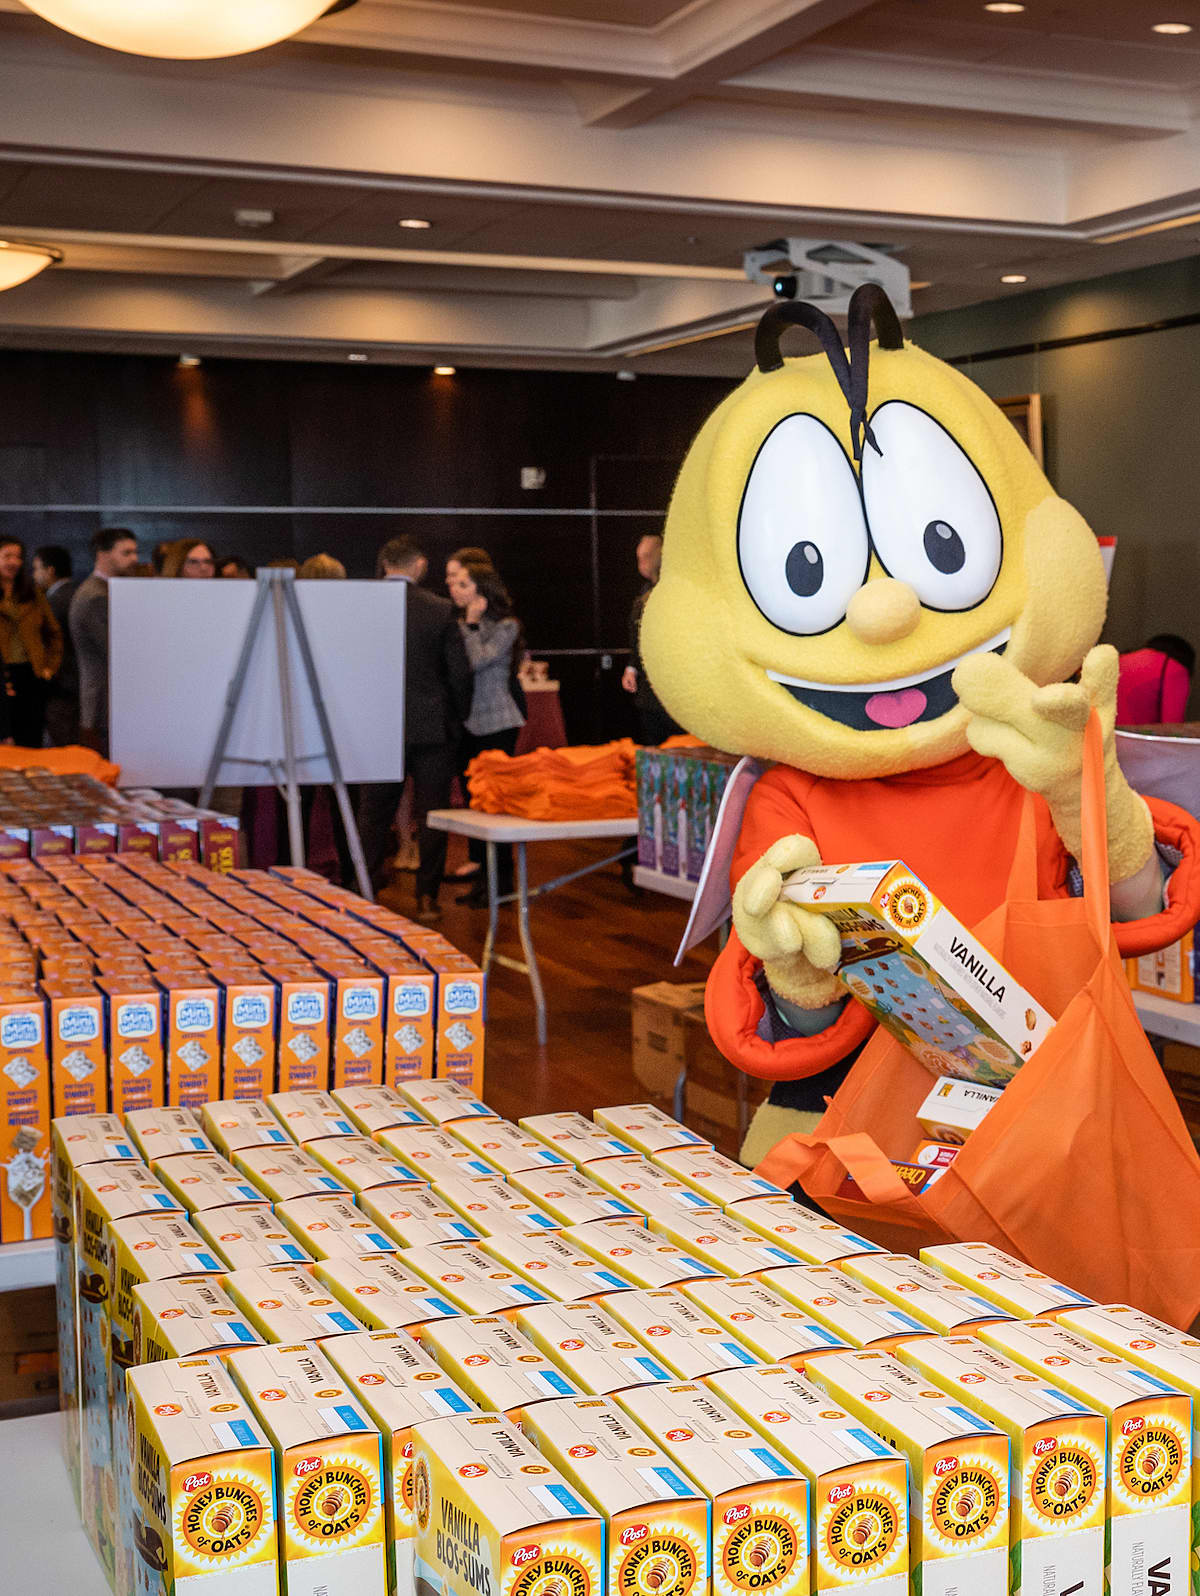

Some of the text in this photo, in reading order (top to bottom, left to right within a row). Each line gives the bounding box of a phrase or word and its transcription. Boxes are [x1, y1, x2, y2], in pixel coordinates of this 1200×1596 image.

[950, 936, 1006, 1004] VANILLA
[1035, 1438, 1056, 1453] Post
[1123, 1418, 1143, 1433] Post
[296, 1459, 320, 1475] Post
[935, 1458, 957, 1474] Post
[1036, 1452, 1092, 1495] HONEY BUNCHES
[1124, 1431, 1179, 1474] HONEY BUNCHES
[184, 1474, 210, 1491] Post
[300, 1476, 323, 1517] HONEY
[326, 1471, 366, 1505] BUNCHES
[829, 1485, 852, 1501] Post
[936, 1471, 995, 1516] HONEY BUNCHES
[187, 1488, 257, 1533] HONEY BUNCHES
[441, 1497, 481, 1556] VANILLA
[725, 1506, 750, 1522] Post
[831, 1498, 893, 1545] HONEY BUNCHES
[513, 1546, 538, 1562] Post
[620, 1527, 647, 1543] Post
[728, 1519, 792, 1566] HONEY BUNCHES
[437, 1530, 491, 1596] BLOS-SUMS
[515, 1565, 541, 1596] ONEY
[624, 1540, 691, 1587] HONEY BUNCHES
